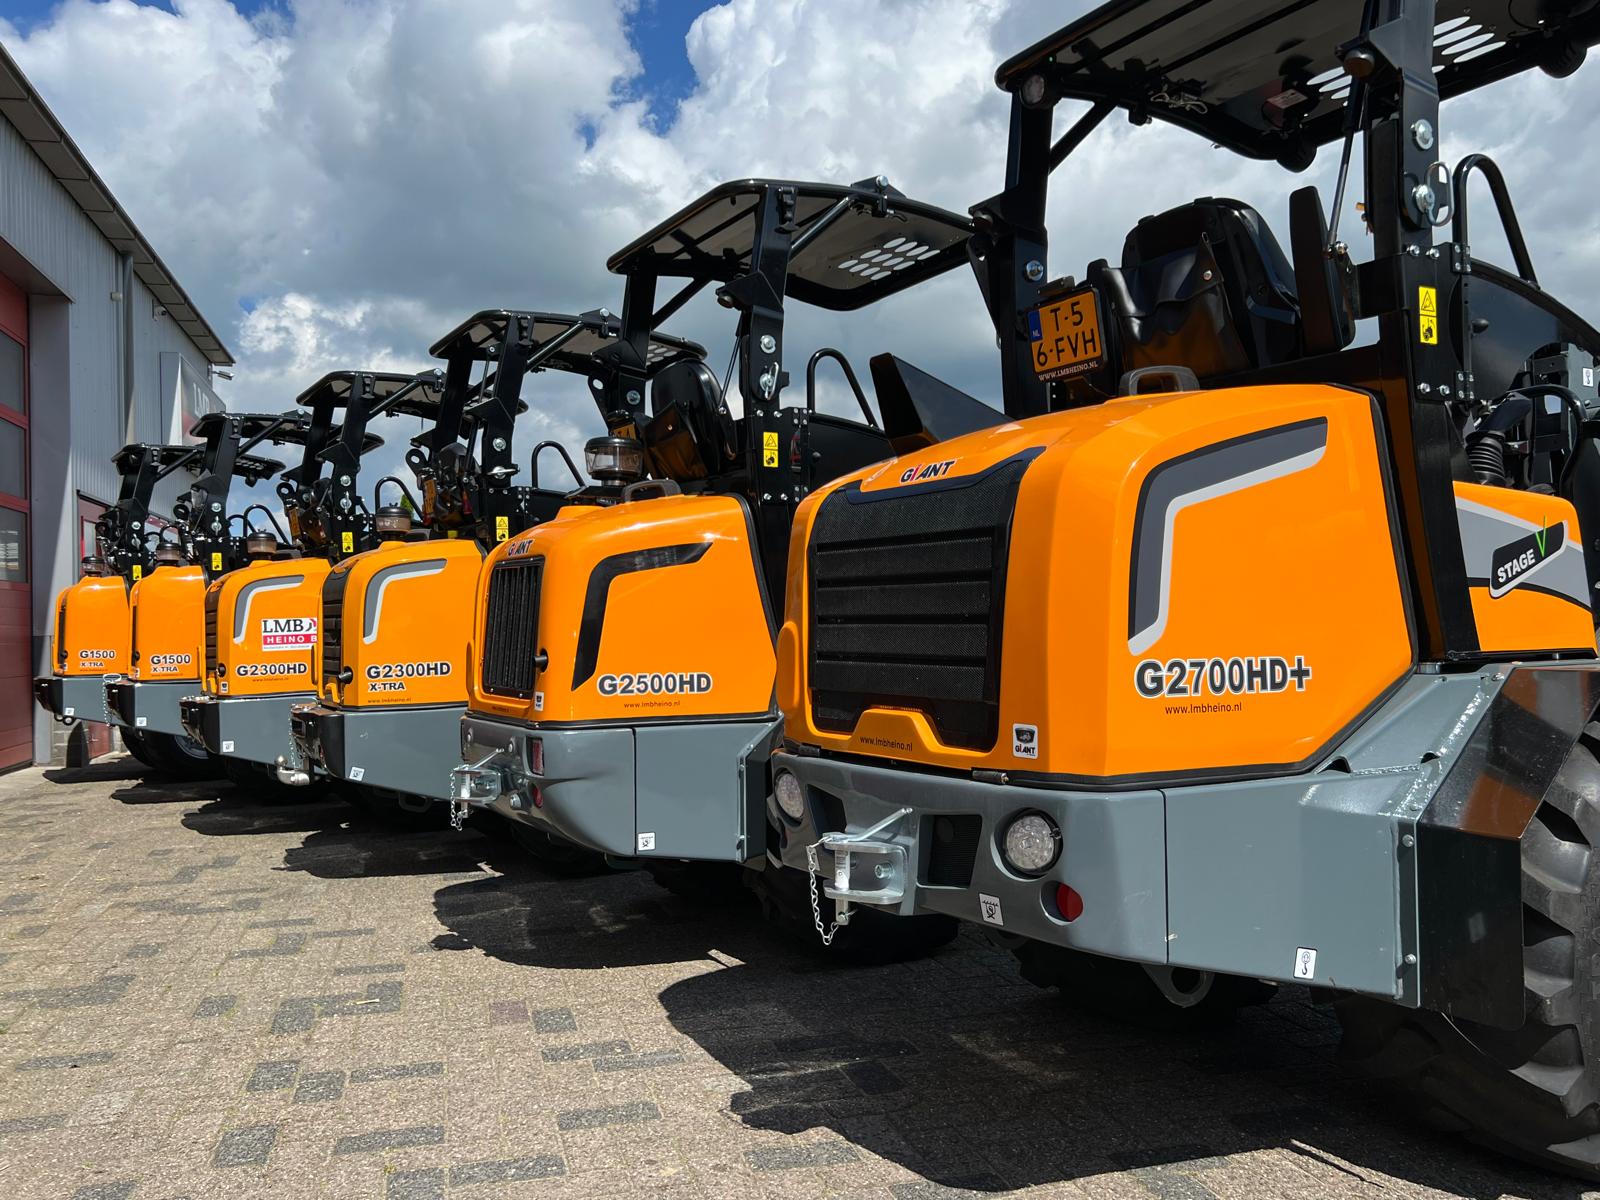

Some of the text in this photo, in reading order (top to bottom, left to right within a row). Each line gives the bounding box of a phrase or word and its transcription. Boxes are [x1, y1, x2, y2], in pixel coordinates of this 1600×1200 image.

[1038, 361, 1099, 381] WWW.LMBHEINO.NL
[900, 460, 956, 483] GIANT
[1497, 548, 1536, 583] STAGE
[262, 619, 304, 633] LMB
[266, 635, 305, 644] HEINO
[79, 650, 116, 659] G1500
[150, 654, 191, 665] G1500
[236, 662, 308, 676] G2300HD
[366, 662, 452, 679] G2300HD
[598, 673, 712, 695] G2500HD
[1135, 657, 1311, 698] G2700HD+
[369, 682, 405, 692] X-TRA
[1165, 702, 1243, 714] www.lmbheino.nl
[860, 736, 913, 751] www.lmbheino.nl
[1015, 744, 1036, 754] GIANT
